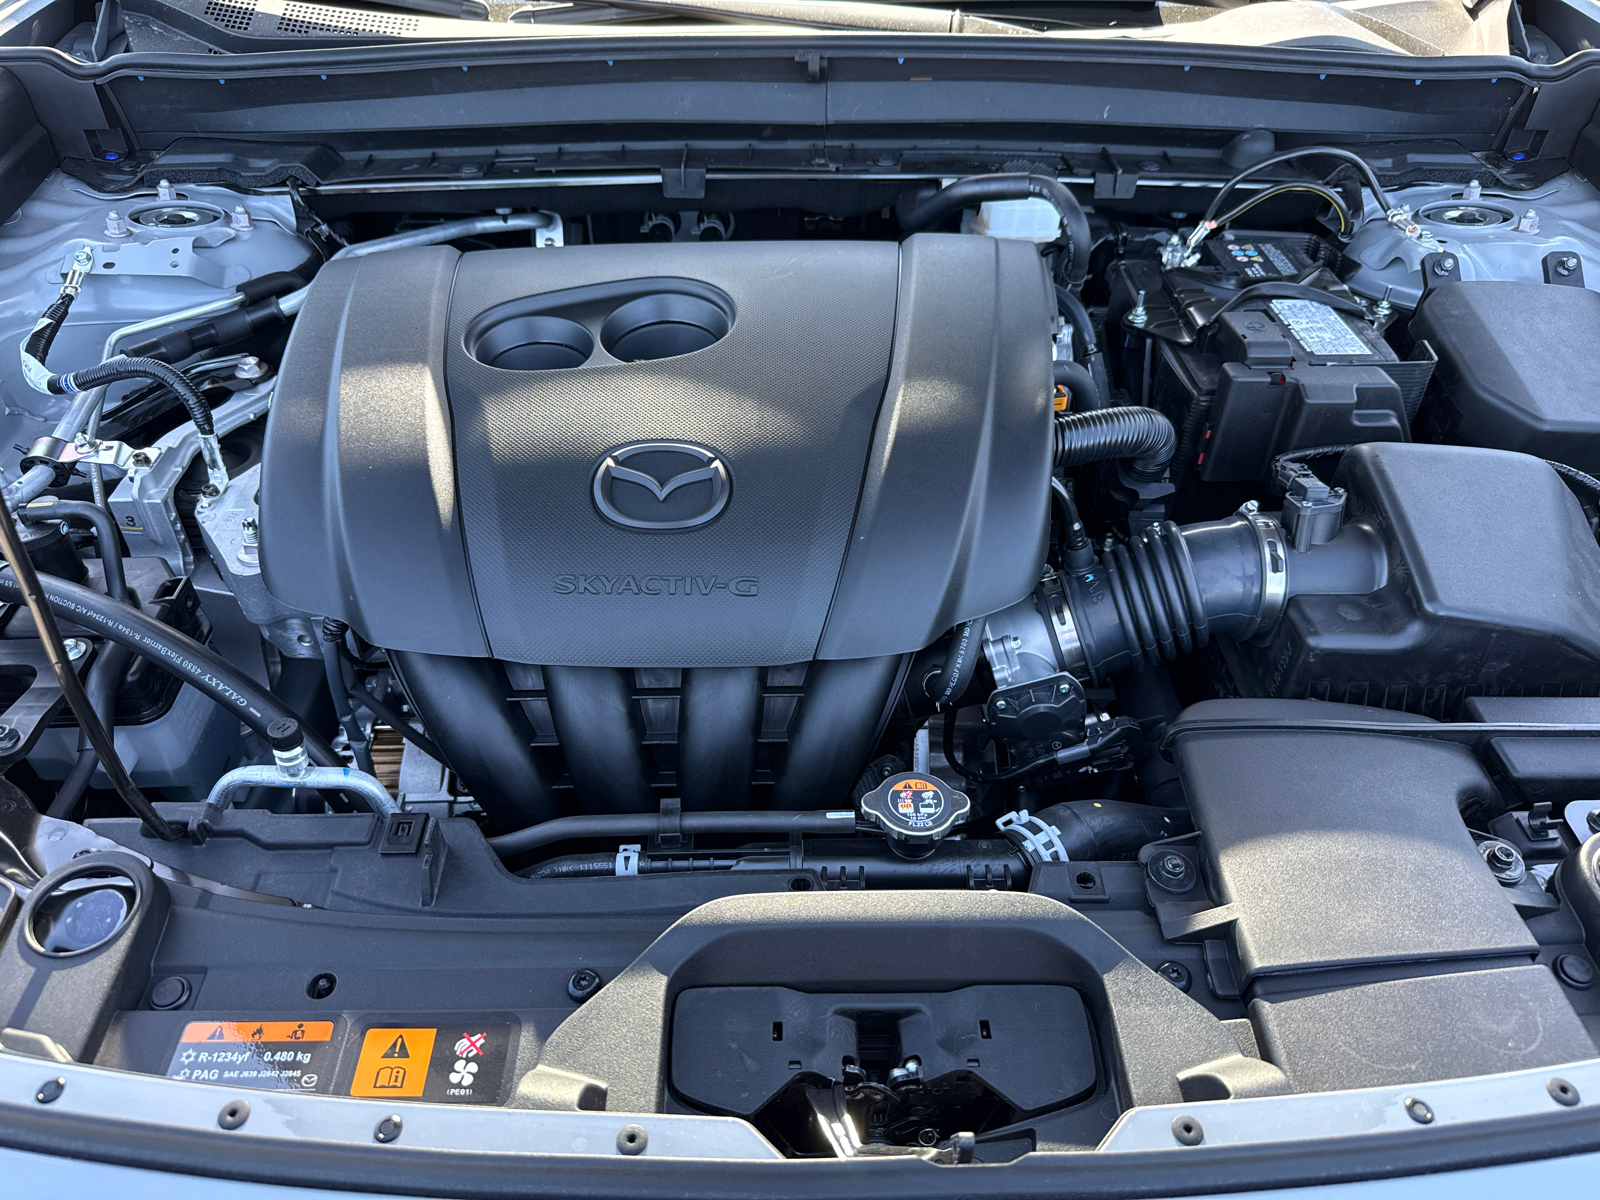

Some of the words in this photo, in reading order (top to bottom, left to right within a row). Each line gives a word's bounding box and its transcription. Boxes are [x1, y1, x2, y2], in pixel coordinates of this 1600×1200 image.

[554, 574, 759, 597] SKYACTIV-G
[49, 594, 76, 610] SUCTION
[118, 624, 142, 640] R-134a
[143, 636, 181, 664] FlexBarrier
[182, 660, 202, 675] 4880
[201, 673, 248, 707] GALAXY
[580, 862, 613, 870] 1115551
[197, 1051, 250, 1065] R-1234yf
[263, 1051, 294, 1062] 0.480
[296, 1051, 312, 1064] kg
[191, 1069, 220, 1080] PAG
[223, 1070, 240, 1078] SAE
[240, 1070, 258, 1078] J639
[447, 1088, 473, 1096] (PE01)
